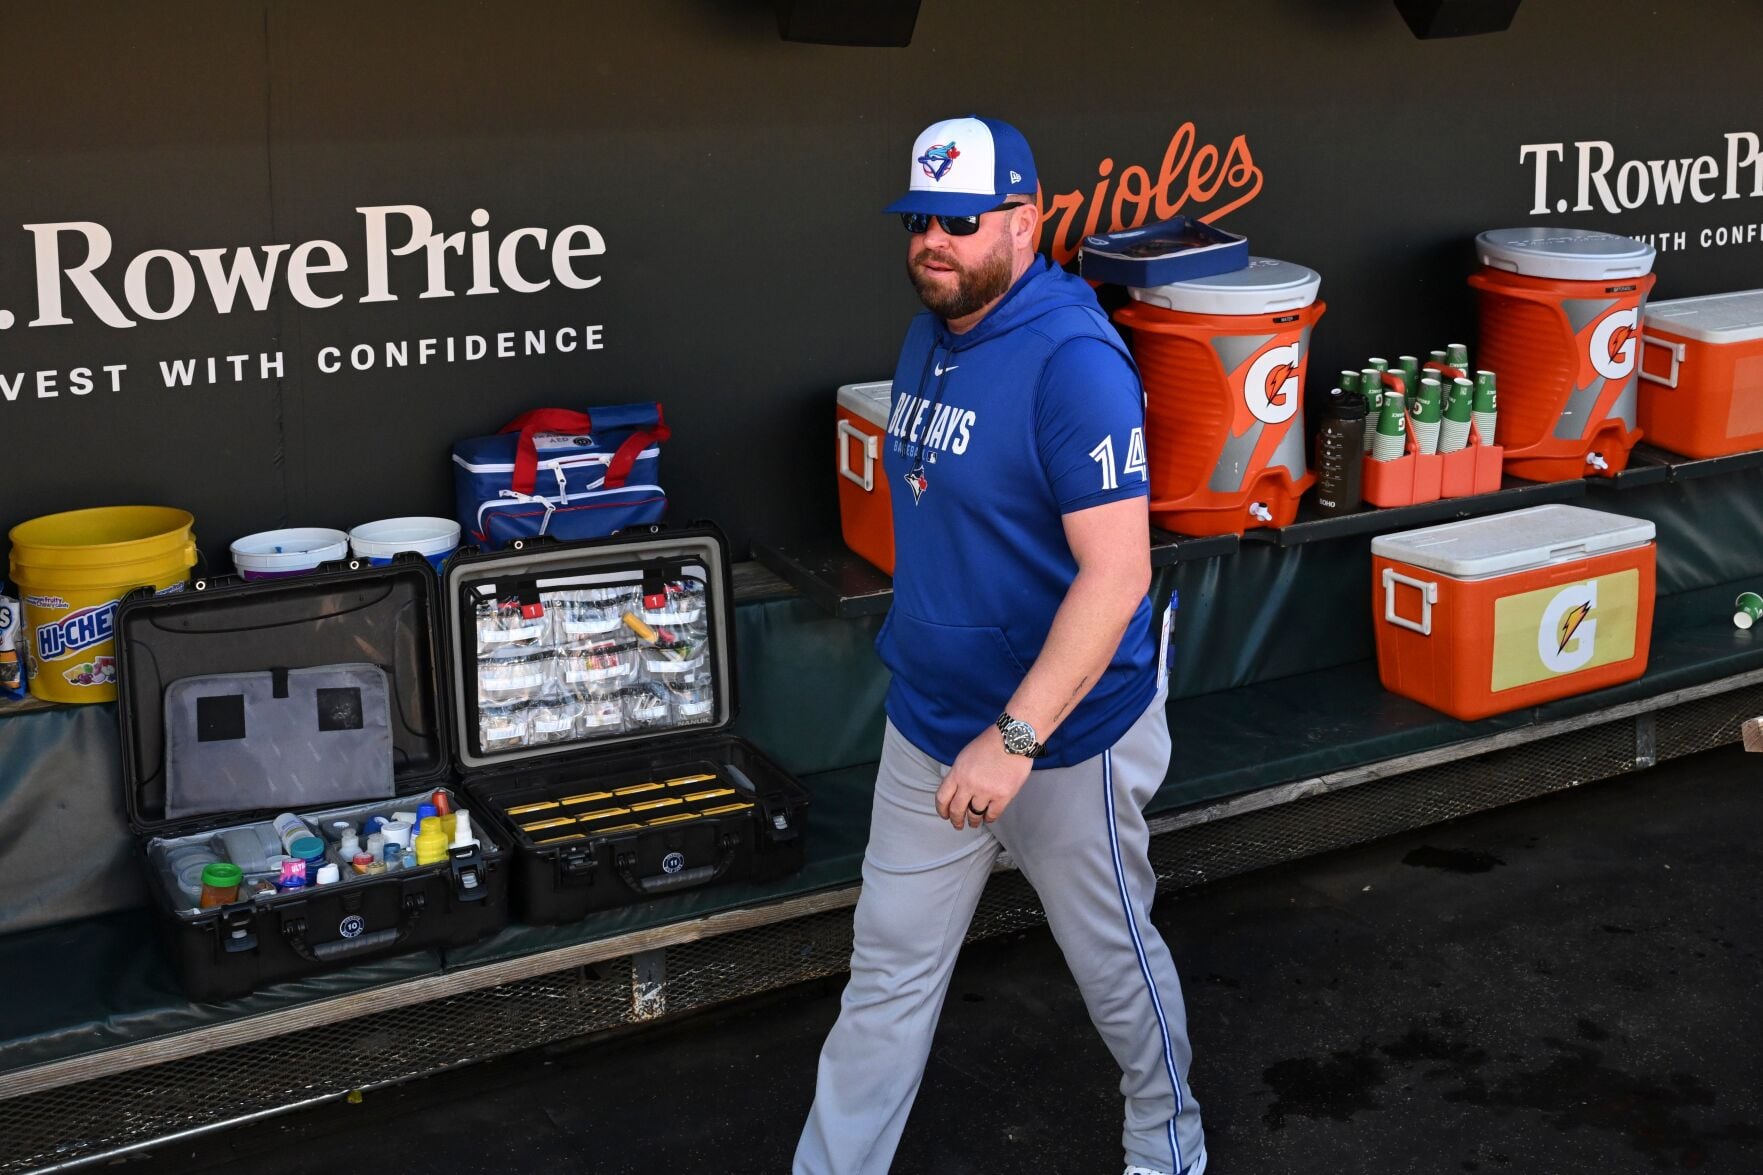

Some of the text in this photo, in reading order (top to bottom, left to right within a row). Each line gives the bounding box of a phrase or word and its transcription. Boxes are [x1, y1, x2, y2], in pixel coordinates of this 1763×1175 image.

[1034, 122, 1264, 265] rioles
[1519, 142, 1568, 215] T.
[1572, 140, 1719, 214] Rowe
[23, 204, 607, 329] Rowe Price
[0, 325, 606, 401] VEST WITH CONFIDENCE
[1589, 306, 1639, 380] G
[1243, 341, 1299, 424] G
[893, 439, 926, 461] BAEBAL
[920, 402, 976, 456] JAYS
[1088, 426, 1149, 491] 14
[529, 606, 536, 616] 1
[651, 597, 658, 606] 1
[1539, 581, 1598, 671] G
[670, 859, 678, 867] 11
[347, 922, 358, 931] 10
